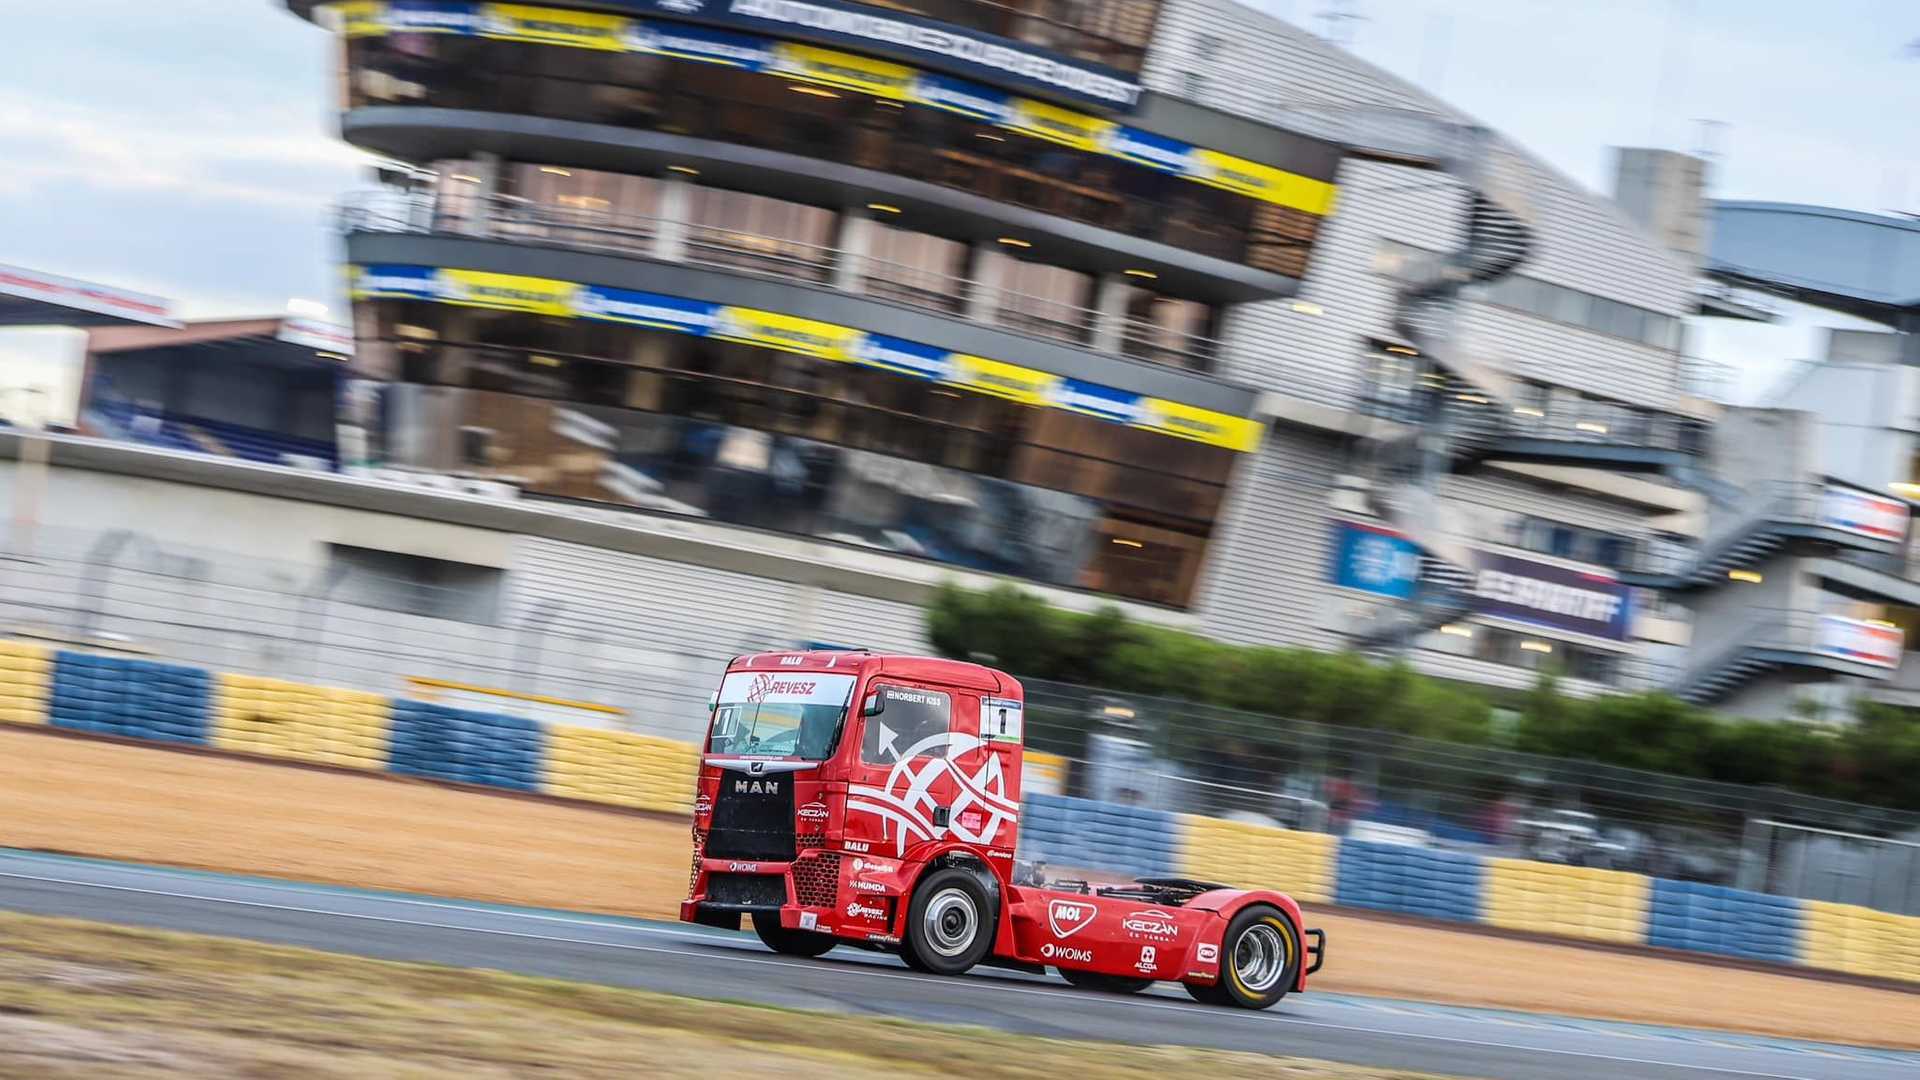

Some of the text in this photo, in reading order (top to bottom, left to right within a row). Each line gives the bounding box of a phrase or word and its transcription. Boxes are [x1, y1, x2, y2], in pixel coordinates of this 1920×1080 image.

[781, 656, 803, 666] BALU
[770, 681, 816, 695] REVESZ
[895, 691, 941, 706] NORBERT KISS
[998, 708, 1007, 734] 1
[735, 780, 779, 794] MAN
[844, 840, 869, 852] BALU
[858, 881, 886, 893] HUMDA
[1055, 905, 1081, 921] MOL
[1055, 946, 1093, 962] WOIMS
[1135, 962, 1158, 971] ALCOA
